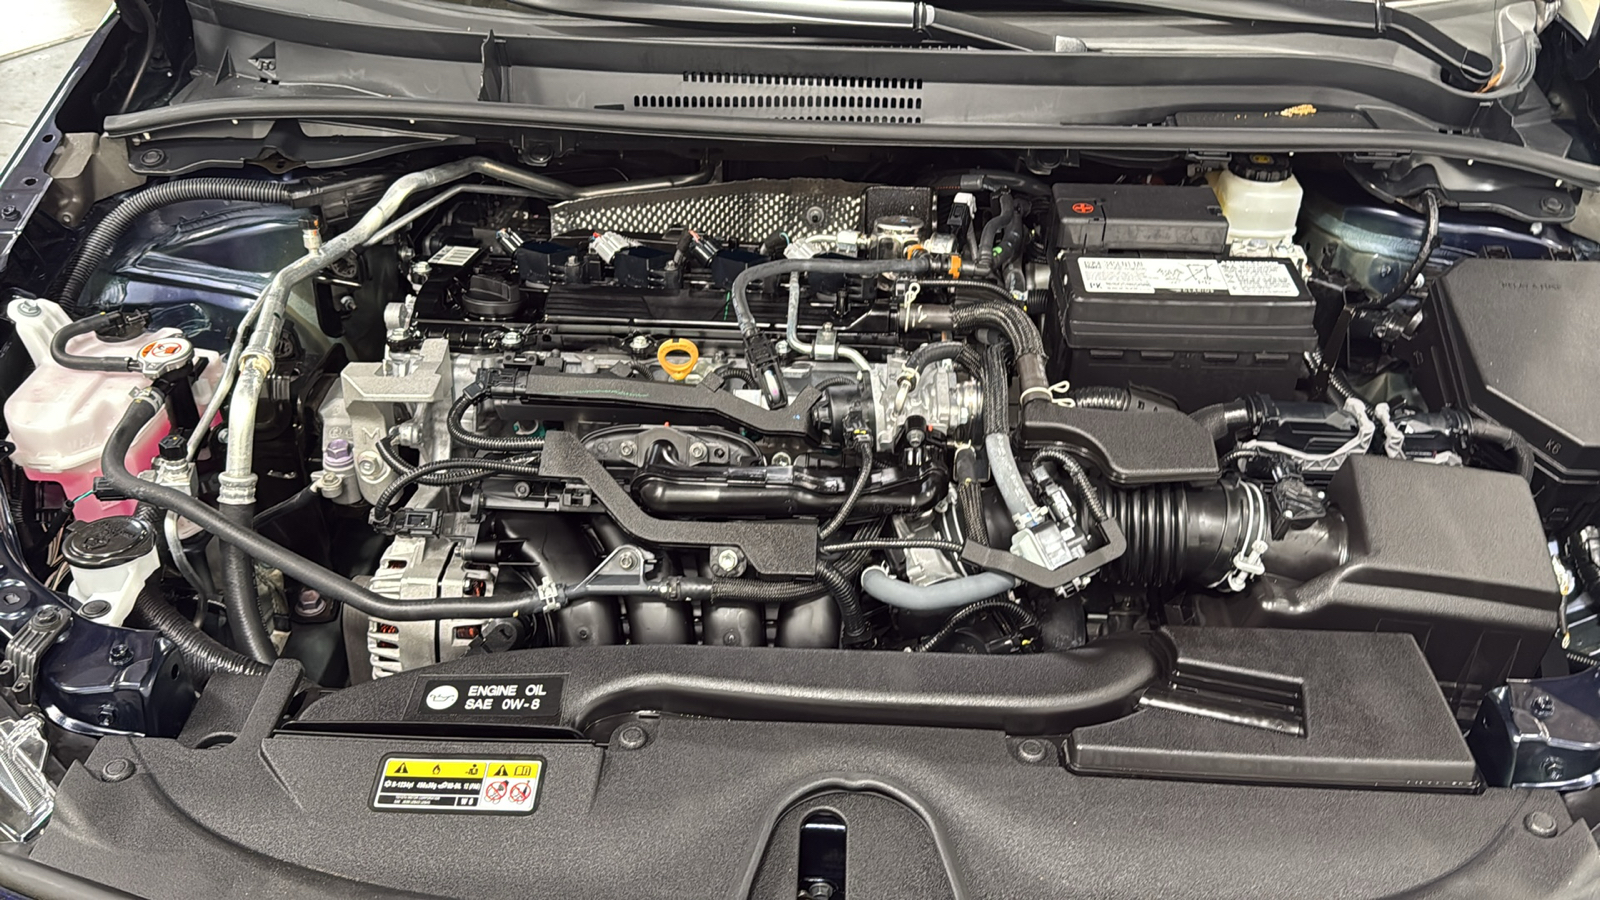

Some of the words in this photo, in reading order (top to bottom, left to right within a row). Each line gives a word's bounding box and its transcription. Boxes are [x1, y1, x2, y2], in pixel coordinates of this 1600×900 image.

[467, 684, 518, 697] ENGINE
[525, 684, 547, 696] OIL
[464, 698, 493, 710] SAE
[501, 698, 541, 710] 0W-8
